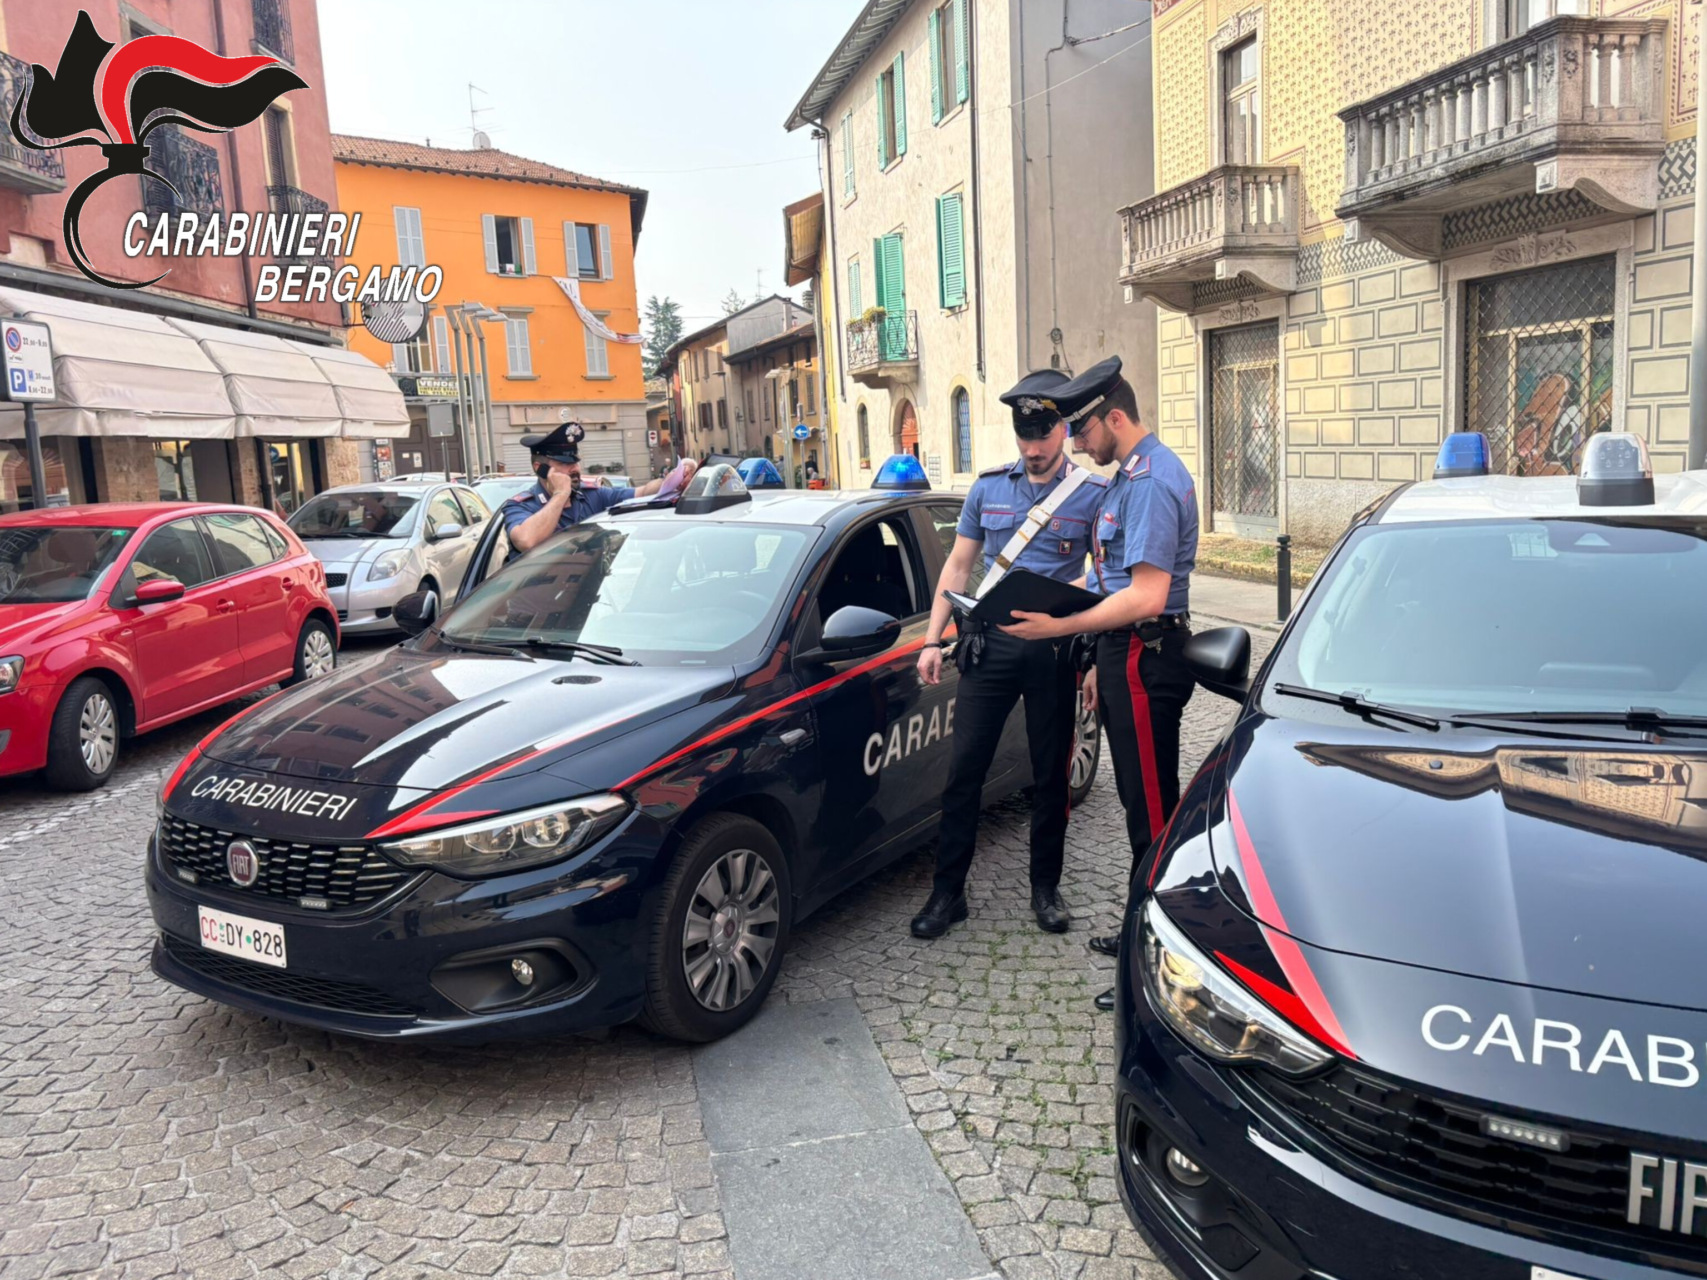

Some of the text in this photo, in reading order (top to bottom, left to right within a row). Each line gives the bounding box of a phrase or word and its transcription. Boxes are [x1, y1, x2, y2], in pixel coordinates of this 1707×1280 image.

[13, 371, 23, 389] P
[191, 775, 358, 821] CARABINIERI
[232, 853, 250, 876] FIAT
[201, 916, 218, 942] CC
[226, 922, 243, 949] DY
[252, 929, 283, 959] 828
[1420, 1004, 1707, 1088] CARAB
